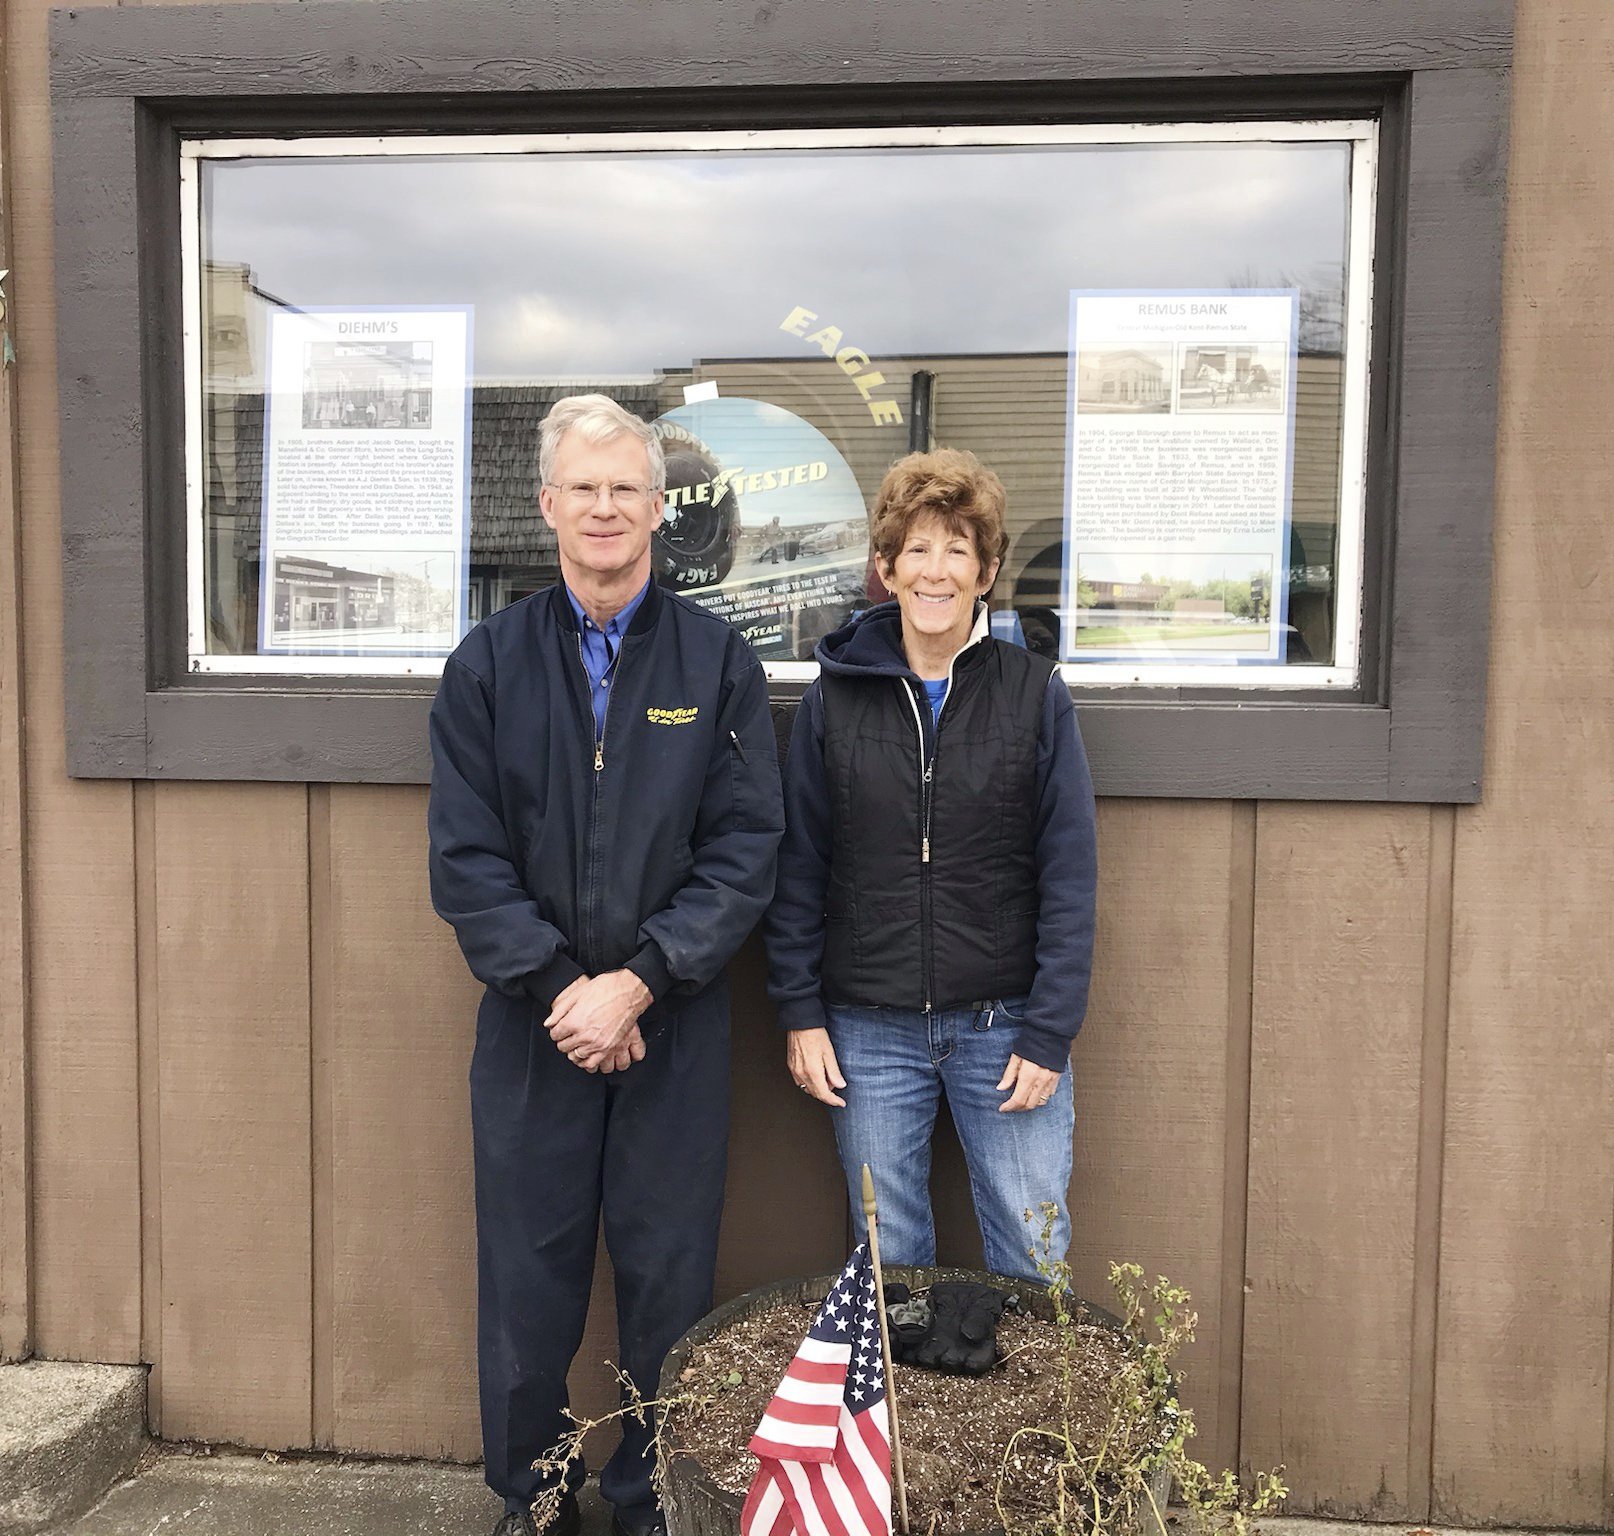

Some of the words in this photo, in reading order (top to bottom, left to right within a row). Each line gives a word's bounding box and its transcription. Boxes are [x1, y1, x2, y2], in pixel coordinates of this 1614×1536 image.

[1138, 304, 1186, 315] REMUS
[1190, 304, 1228, 315] BANK
[338, 320, 398, 334] DIEHM'S
[779, 305, 904, 427] EAGLE
[664, 482, 711, 508] TLE
[729, 461, 828, 497] TESTED
[723, 594, 736, 602] PUT
[772, 582, 791, 594] TIRES
[790, 581, 800, 590] TO
[800, 579, 813, 588] THE
[814, 576, 828, 586] TEST
[829, 574, 838, 582] IN
[734, 602, 742, 610] OF
[774, 594, 786, 604] AND
[786, 587, 825, 601] EVERYTHING
[825, 584, 836, 594] WE
[730, 610, 760, 622] INSPIRES
[760, 606, 778, 616] WHAT
[778, 604, 790, 614] WE
[790, 600, 806, 612] ROLL
[806, 598, 821, 608] INTO
[822, 594, 846, 604] YOURS.
[647, 706, 698, 720] GOODYEAR
